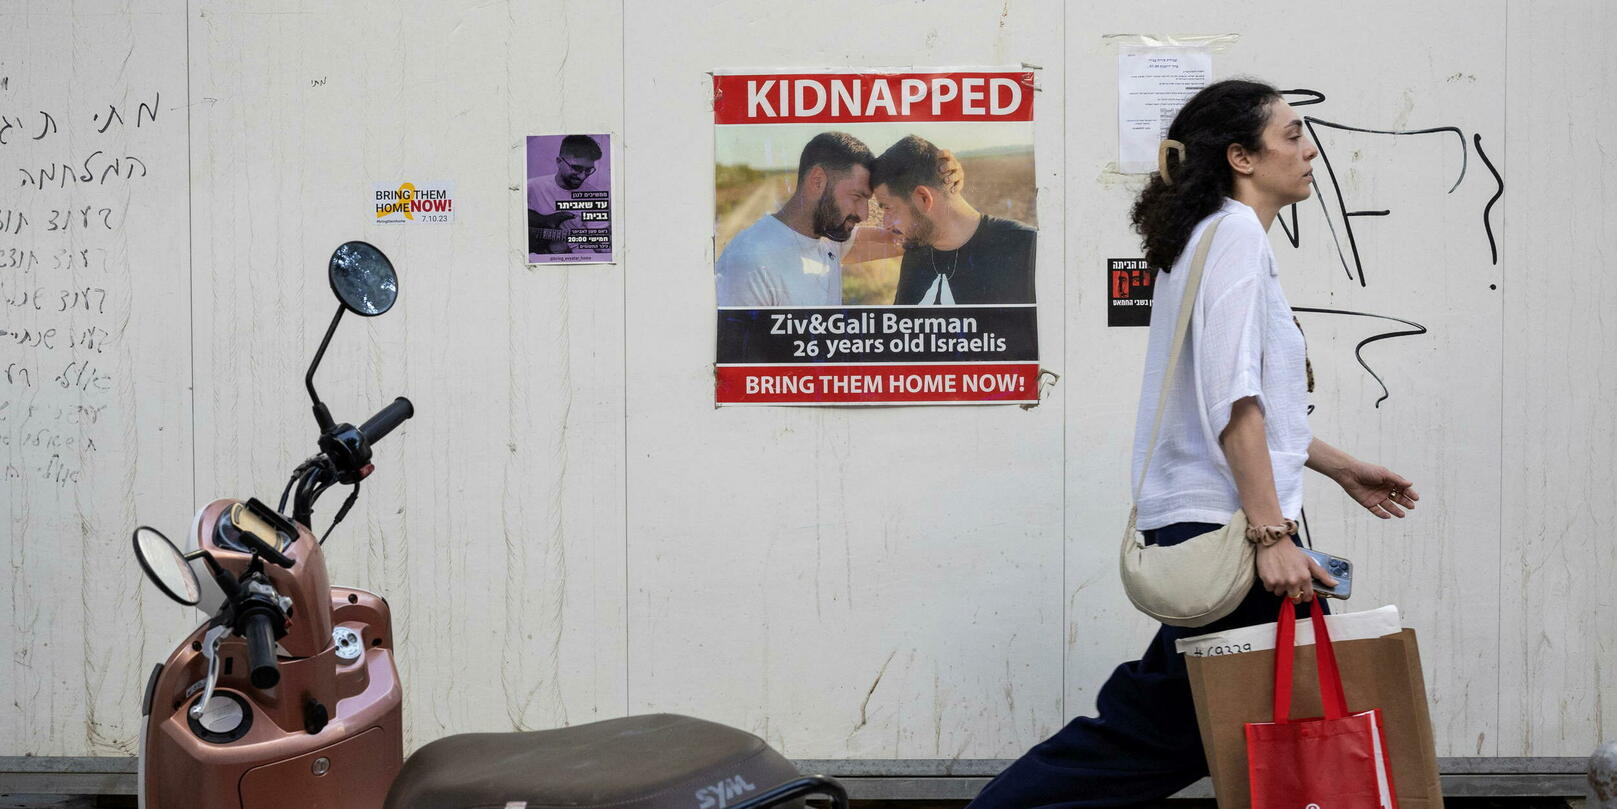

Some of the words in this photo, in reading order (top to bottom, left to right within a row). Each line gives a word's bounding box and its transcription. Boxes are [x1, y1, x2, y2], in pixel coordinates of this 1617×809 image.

[747, 78, 1022, 118] KIDNAPPED
[93, 92, 160, 133] מתי
[19, 151, 147, 190] המלחמה
[376, 190, 411, 200] BRING
[414, 190, 446, 200] THEM
[376, 203, 410, 213] HOME
[410, 199, 452, 213] NOW!
[557, 201, 593, 209] שאביתר
[422, 215, 448, 223] 7.10.23
[583, 212, 608, 220] בבית!
[1112, 261, 1137, 269] הביתה
[770, 313, 875, 336] Ziv&Gali
[882, 313, 978, 334] Berman
[793, 340, 819, 357] 26
[826, 337, 885, 358] years
[889, 334, 925, 353] old
[930, 333, 1007, 353] Israelis
[745, 375, 815, 395] BRING
[819, 375, 883, 394] THEM
[889, 374, 957, 393] HOME
[962, 373, 1026, 393] NOW!
[695, 774, 757, 809] SYM
